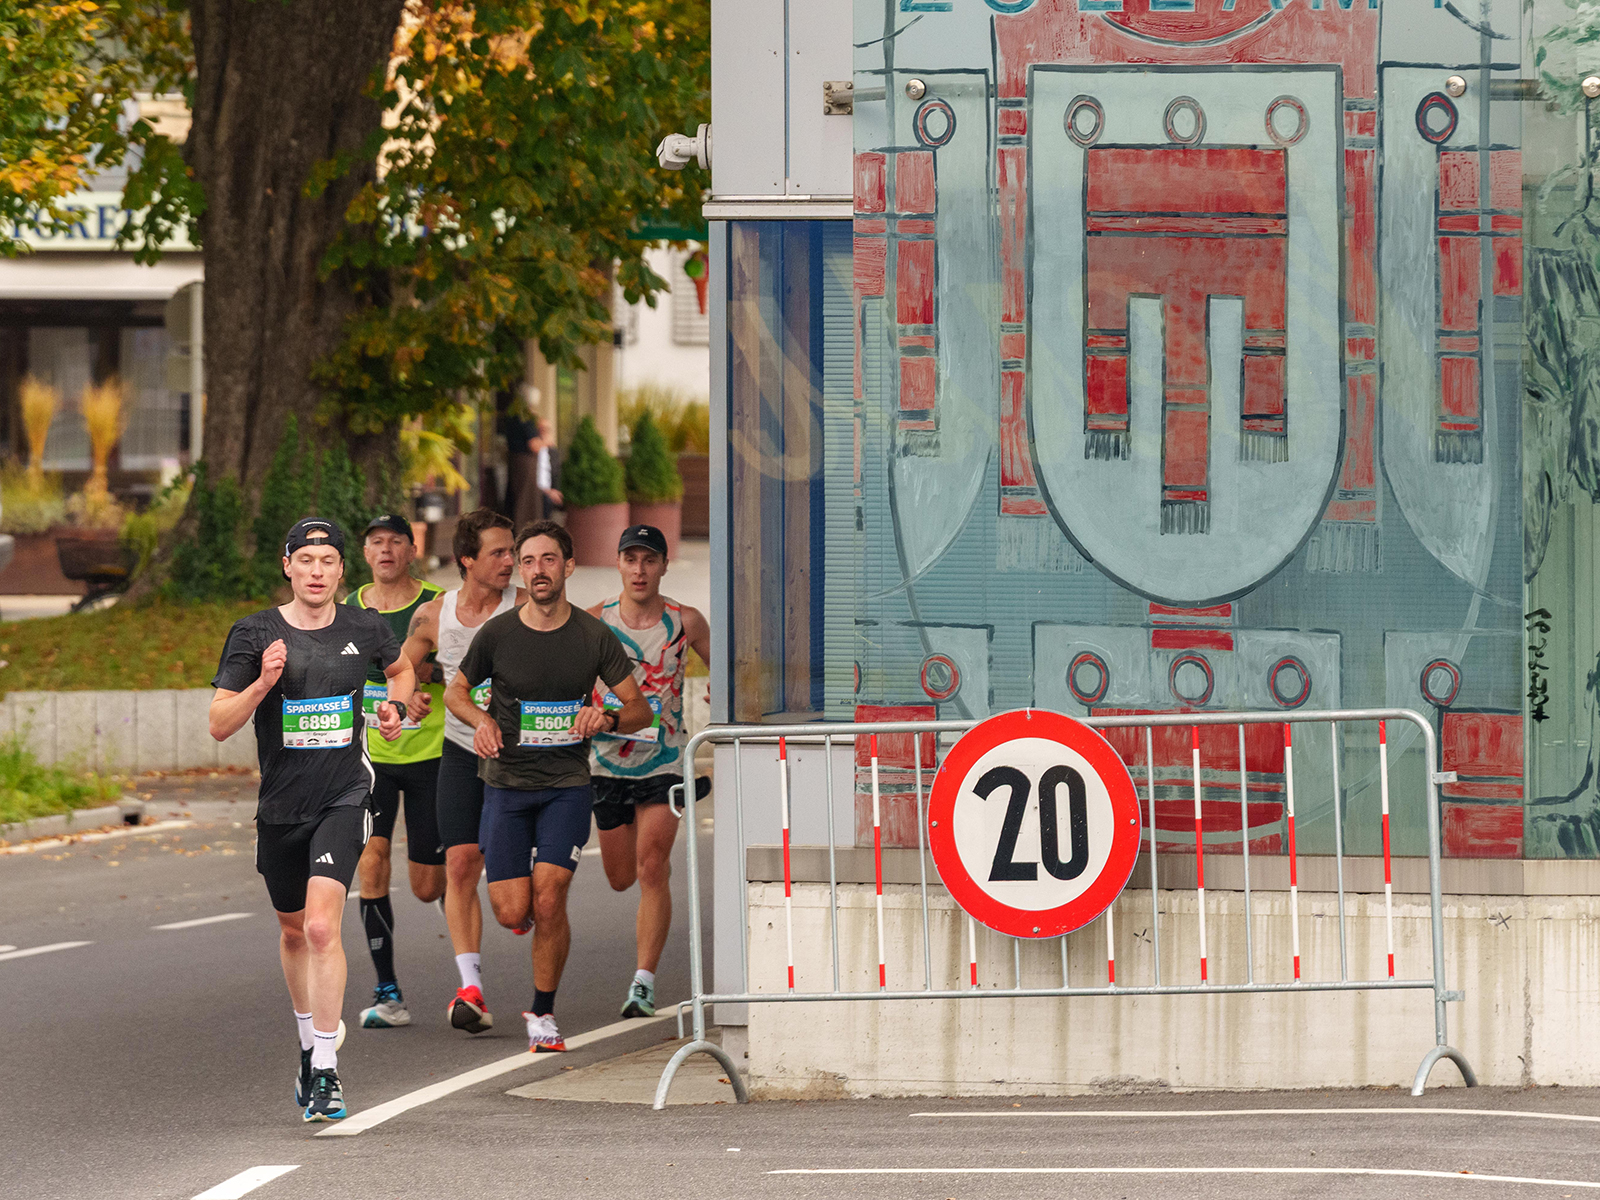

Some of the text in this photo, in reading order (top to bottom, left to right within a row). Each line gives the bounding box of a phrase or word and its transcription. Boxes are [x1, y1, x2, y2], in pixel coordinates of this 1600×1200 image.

[286, 702, 340, 714] SPARKASSE
[524, 705, 573, 714] SPARKASSE
[299, 714, 340, 730] 6899
[535, 716, 572, 730] 5604
[972, 764, 1089, 882] 20
